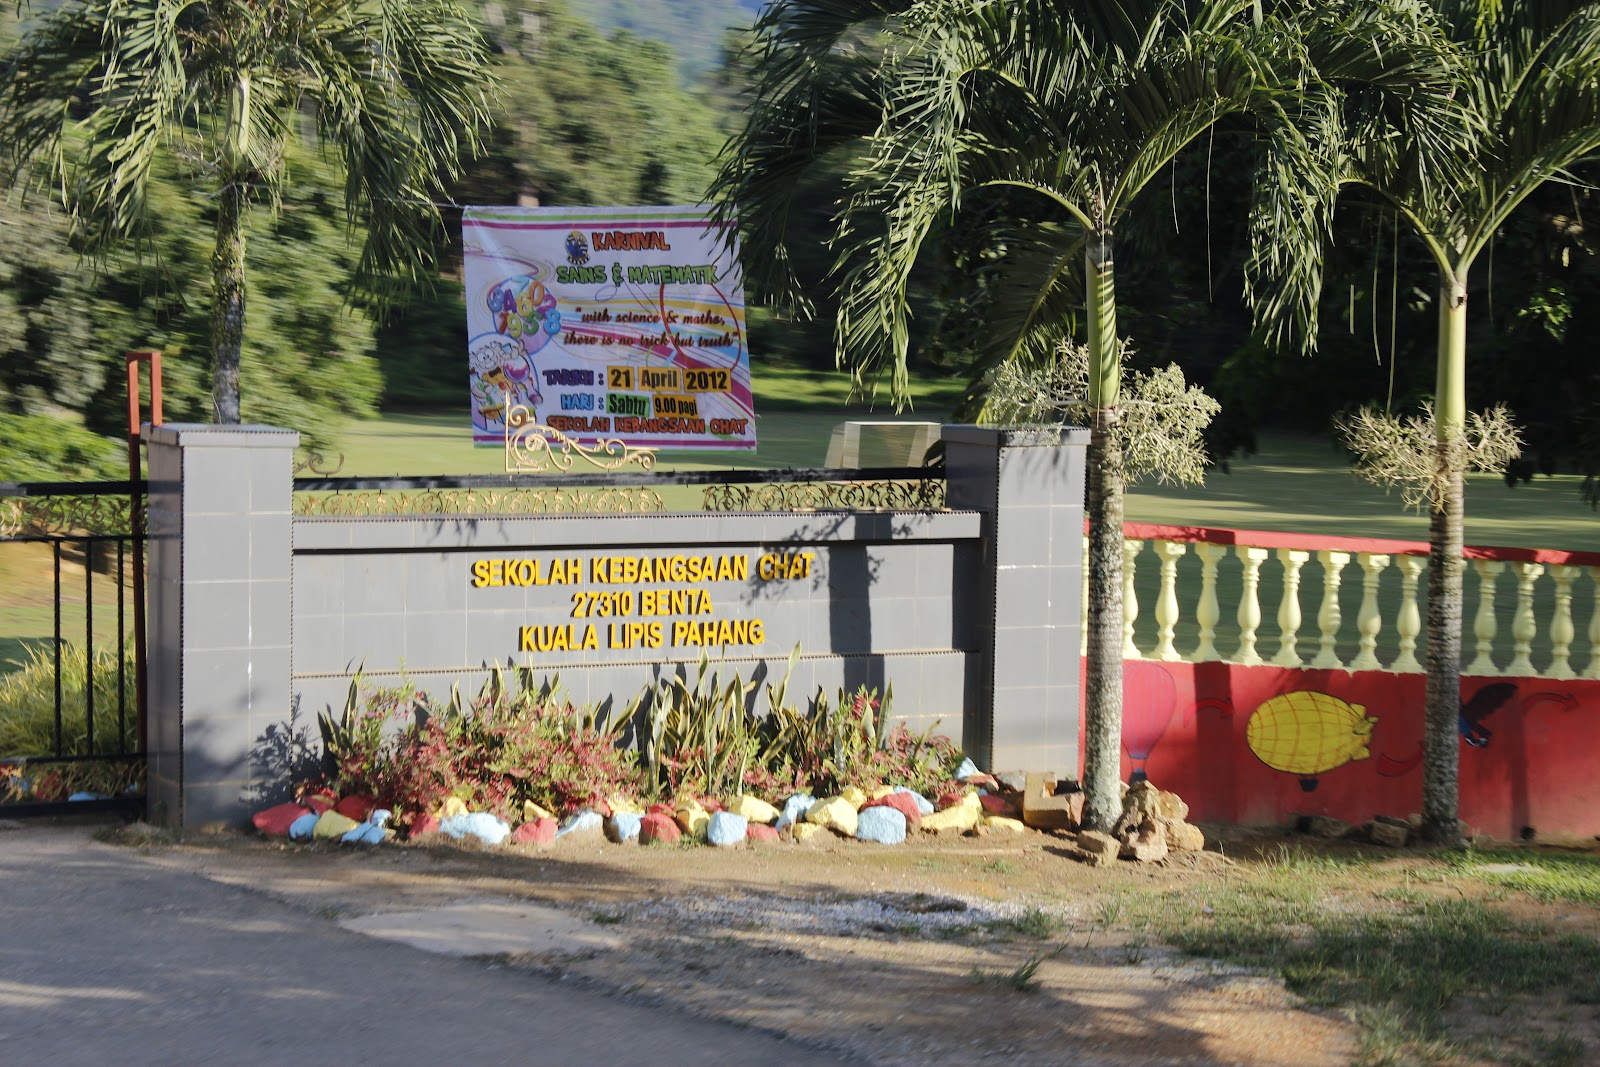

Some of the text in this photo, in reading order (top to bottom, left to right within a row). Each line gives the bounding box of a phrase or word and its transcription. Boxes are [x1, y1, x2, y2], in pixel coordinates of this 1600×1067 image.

[592, 231, 670, 251] KARNIVAL
[556, 266, 607, 284] SAINS
[628, 265, 719, 285] MATEMATIK
[616, 312, 660, 323] science
[667, 310, 678, 323] &
[564, 331, 598, 345] there
[602, 334, 615, 345] is
[619, 336, 634, 345] no
[640, 332, 670, 346] trick
[674, 332, 694, 346] but
[611, 369, 630, 388] 21
[641, 369, 677, 388] April
[686, 371, 727, 389] 2012
[561, 394, 594, 411] HARI
[609, 394, 646, 415] Sabtu
[655, 397, 676, 413] 9.00
[678, 399, 697, 415] pagi
[546, 416, 748, 435] SEKOLAH KEBANGSAAN CHAT
[472, 553, 815, 588] SEKOLAH KEBANGSAAN CHAT
[571, 589, 713, 619] 27310 BENTA
[519, 619, 764, 652] KUALA LIPIS PAHANG
